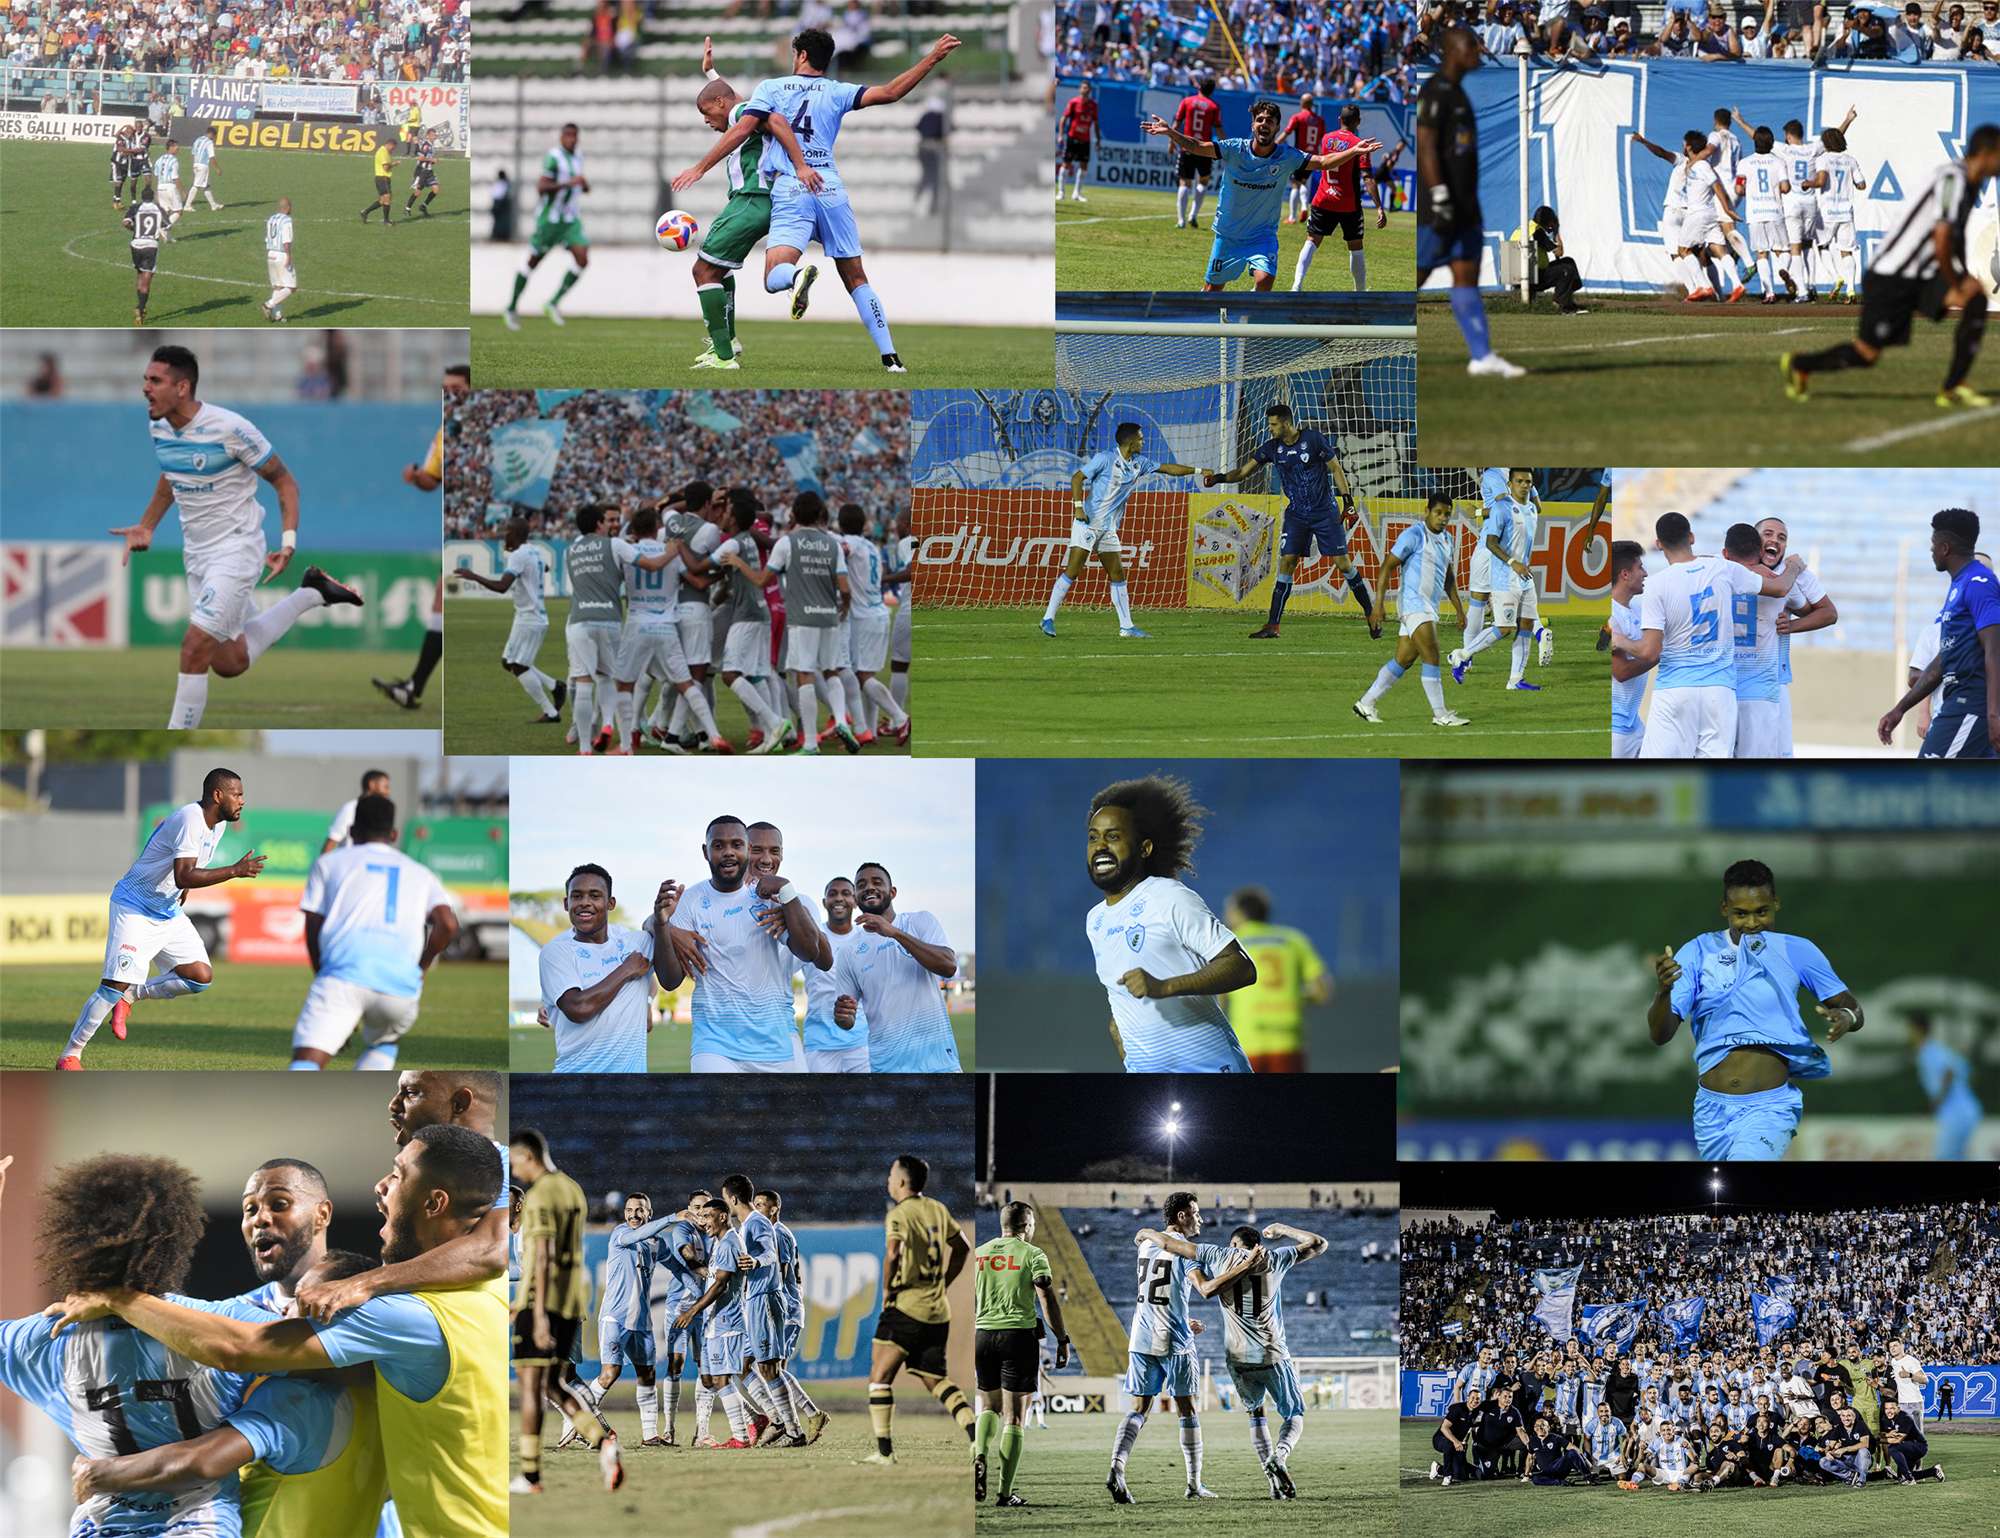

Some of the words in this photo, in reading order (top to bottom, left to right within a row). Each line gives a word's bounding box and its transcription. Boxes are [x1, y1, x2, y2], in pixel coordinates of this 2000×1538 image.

[190, 77, 260, 103] FALANGE
[0, 120, 22, 133] RES
[27, 121, 66, 136] GALLI
[72, 122, 117, 138] HOTEL
[790, 99, 815, 143] 4
[1192, 109, 1206, 132] 6
[210, 120, 377, 152] TeleListas
[1306, 125, 1319, 145] 8
[1097, 146, 1127, 163] CENTRO
[1132, 148, 1143, 164] DE
[1096, 165, 1180, 188] LONDRIN
[1757, 168, 1770, 193] 8
[1794, 160, 1808, 180] 9
[1834, 169, 1845, 194] 7
[143, 215, 154, 236] 9
[1211, 257, 1224, 273] 10
[796, 537, 830, 552] Karilu
[634, 560, 664, 590] 10
[803, 606, 838, 615] Unimed
[1689, 585, 1719, 646] 5
[1731, 593, 1758, 647] 9
[366, 863, 400, 925] 7
[976, 1255, 1021, 1271] TCL
[1137, 1257, 1173, 1306] 22
[1232, 1274, 1262, 1318] 11
